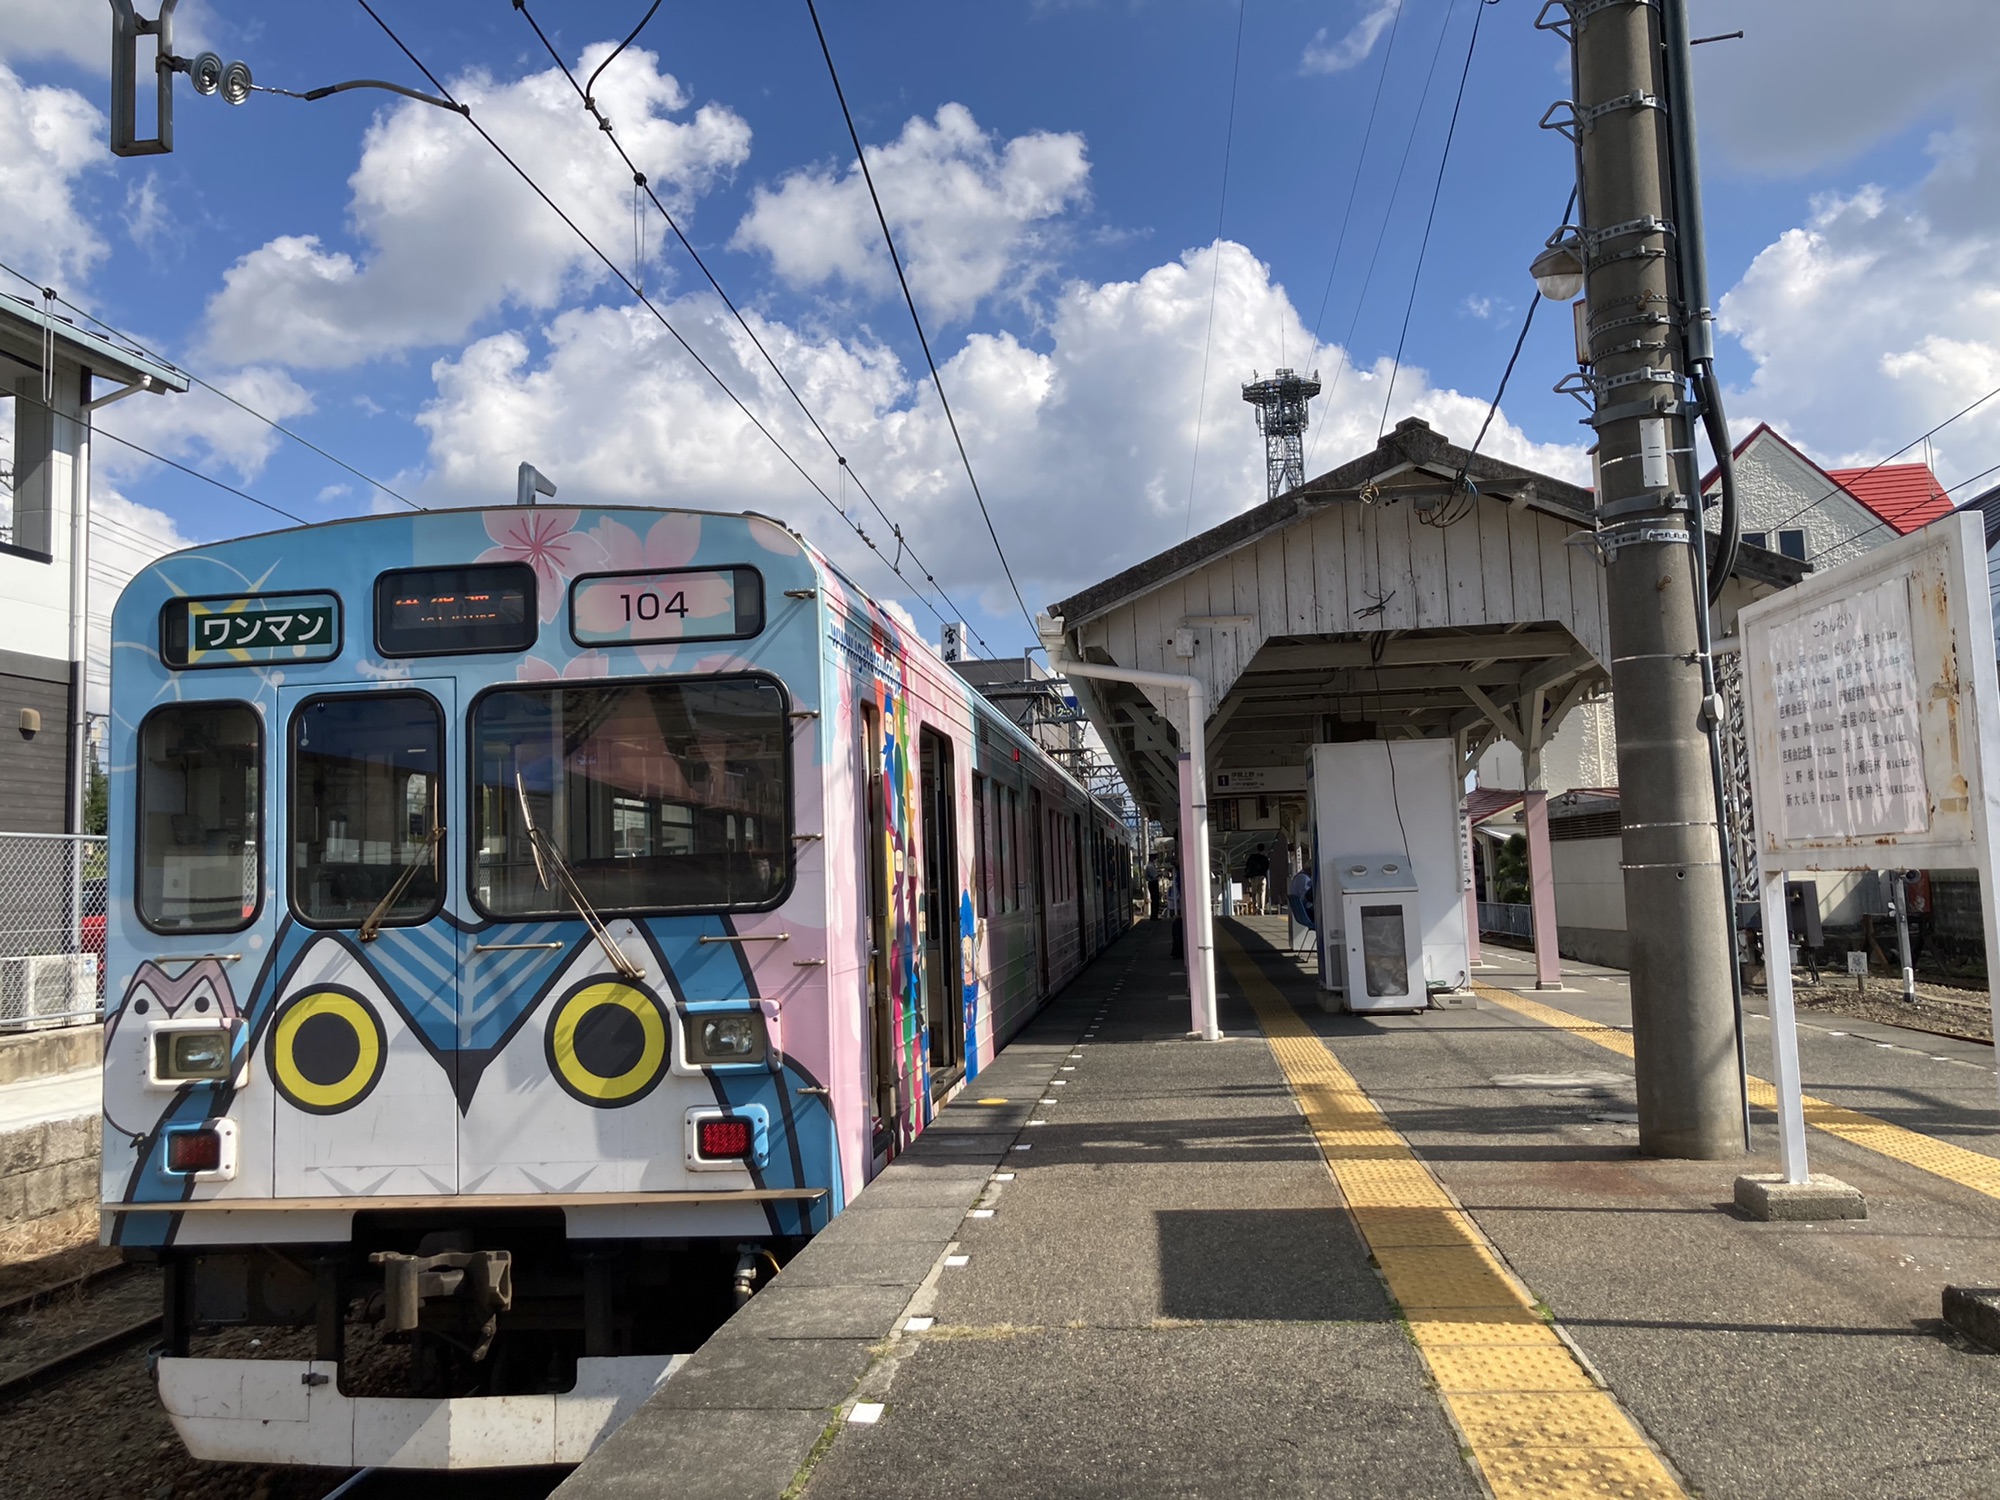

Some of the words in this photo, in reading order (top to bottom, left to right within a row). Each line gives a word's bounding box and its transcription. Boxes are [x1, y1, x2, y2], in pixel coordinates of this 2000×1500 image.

[621, 591, 689, 622] 104
[202, 613, 325, 647] ワンマン
[1813, 613, 1852, 638] ごあんない
[1783, 746, 1812, 762] 芭蕉翁記念館
[1785, 768, 1814, 784] 上野城
[1786, 791, 1816, 807] 新大仏寺
